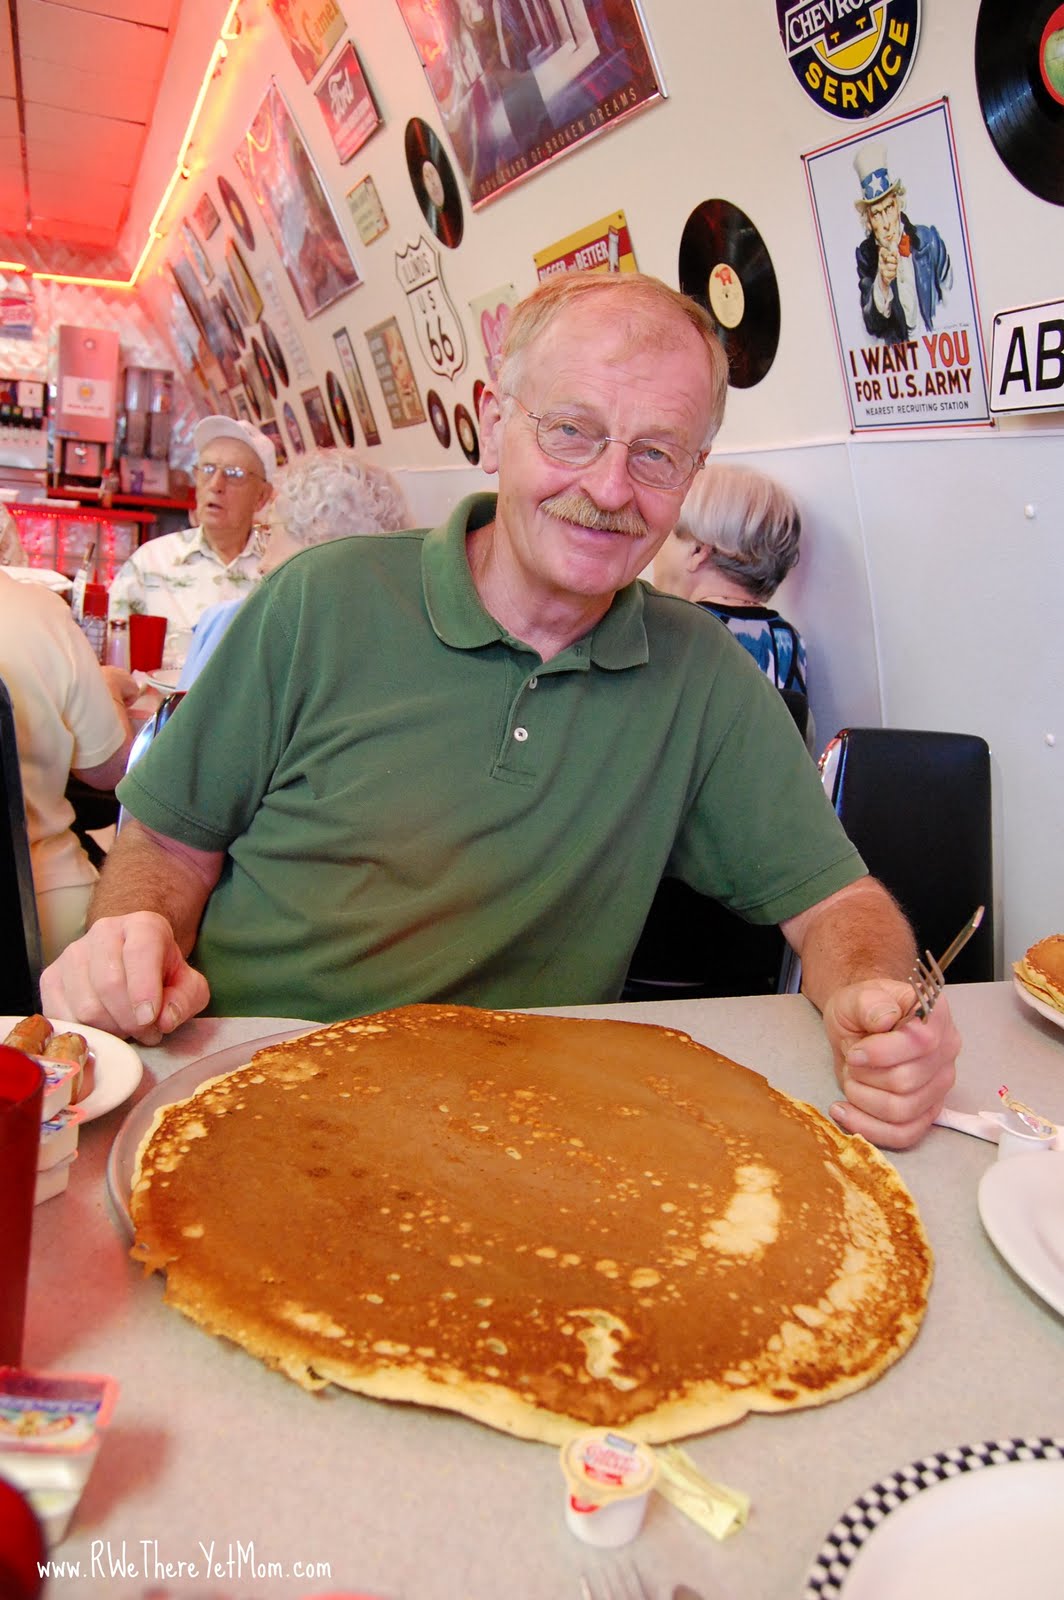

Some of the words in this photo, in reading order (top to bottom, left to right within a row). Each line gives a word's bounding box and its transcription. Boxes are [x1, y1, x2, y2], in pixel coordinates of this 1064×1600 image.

[804, 18, 910, 109] SERVICE
[532, 148, 544, 163] OF
[545, 119, 587, 157] BROKEN
[589, 88, 638, 127] DREAMS
[575, 240, 609, 271] BETTER
[426, 315, 455, 367] 66
[849, 350, 858, 377] I
[861, 341, 919, 376] WANT
[922, 330, 970, 369] YOU
[855, 380, 882, 402] FOR
[865, 406, 894, 416] NEAREST
[897, 403, 938, 413] RECRUITING
[940, 401, 969, 411] STATION
